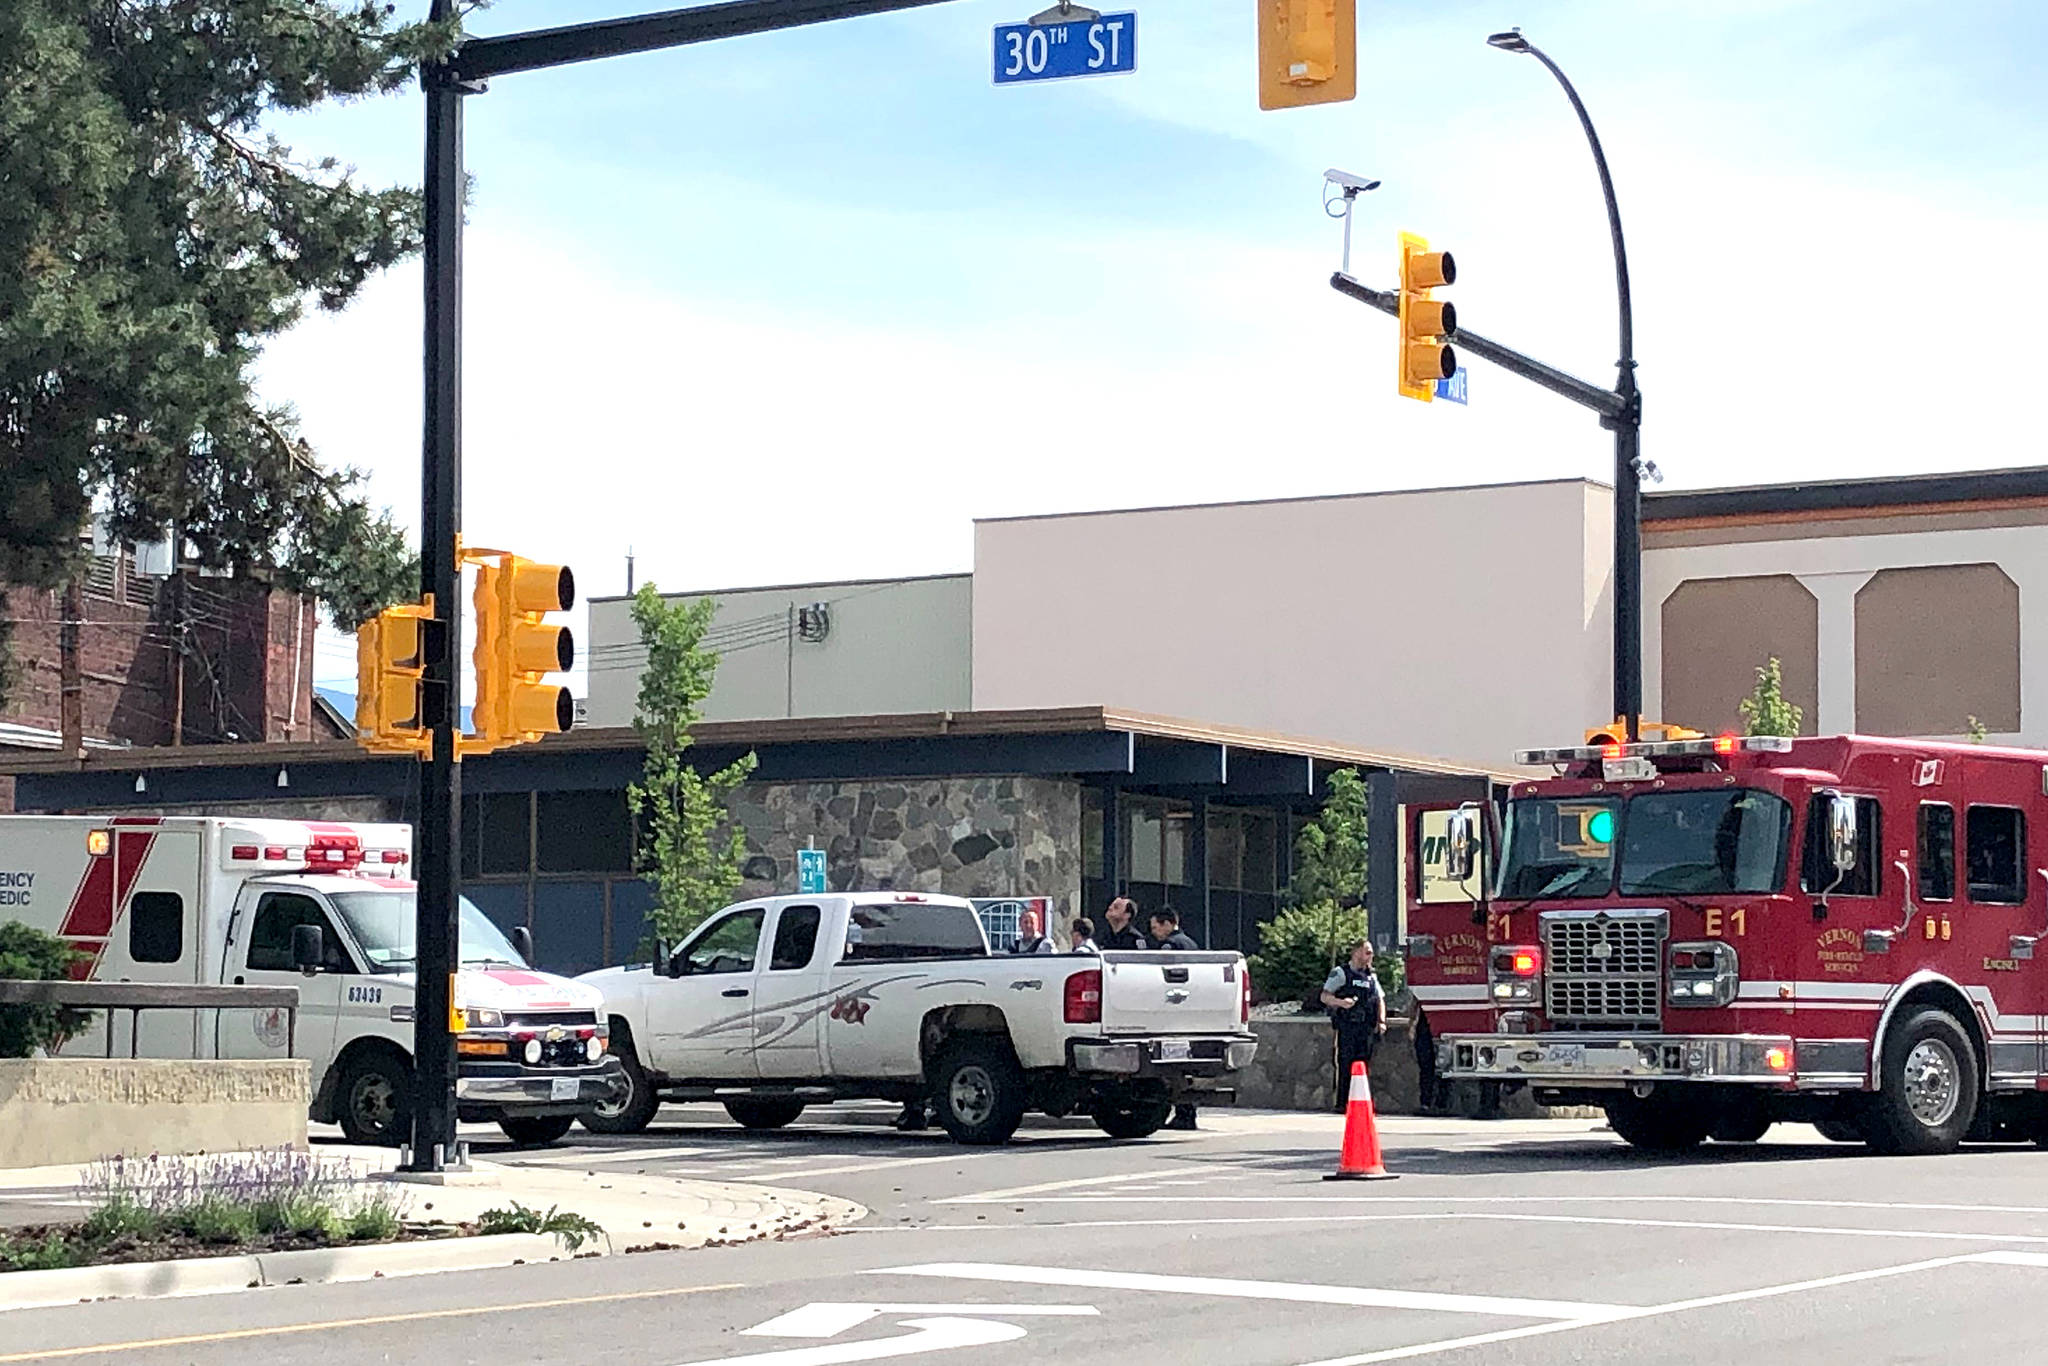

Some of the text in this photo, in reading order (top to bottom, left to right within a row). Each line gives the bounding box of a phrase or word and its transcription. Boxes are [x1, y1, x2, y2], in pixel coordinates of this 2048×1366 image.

[1005, 21, 1124, 76] 30TH ST
[0, 872, 35, 888] ENCY
[0, 890, 31, 906] EDIC
